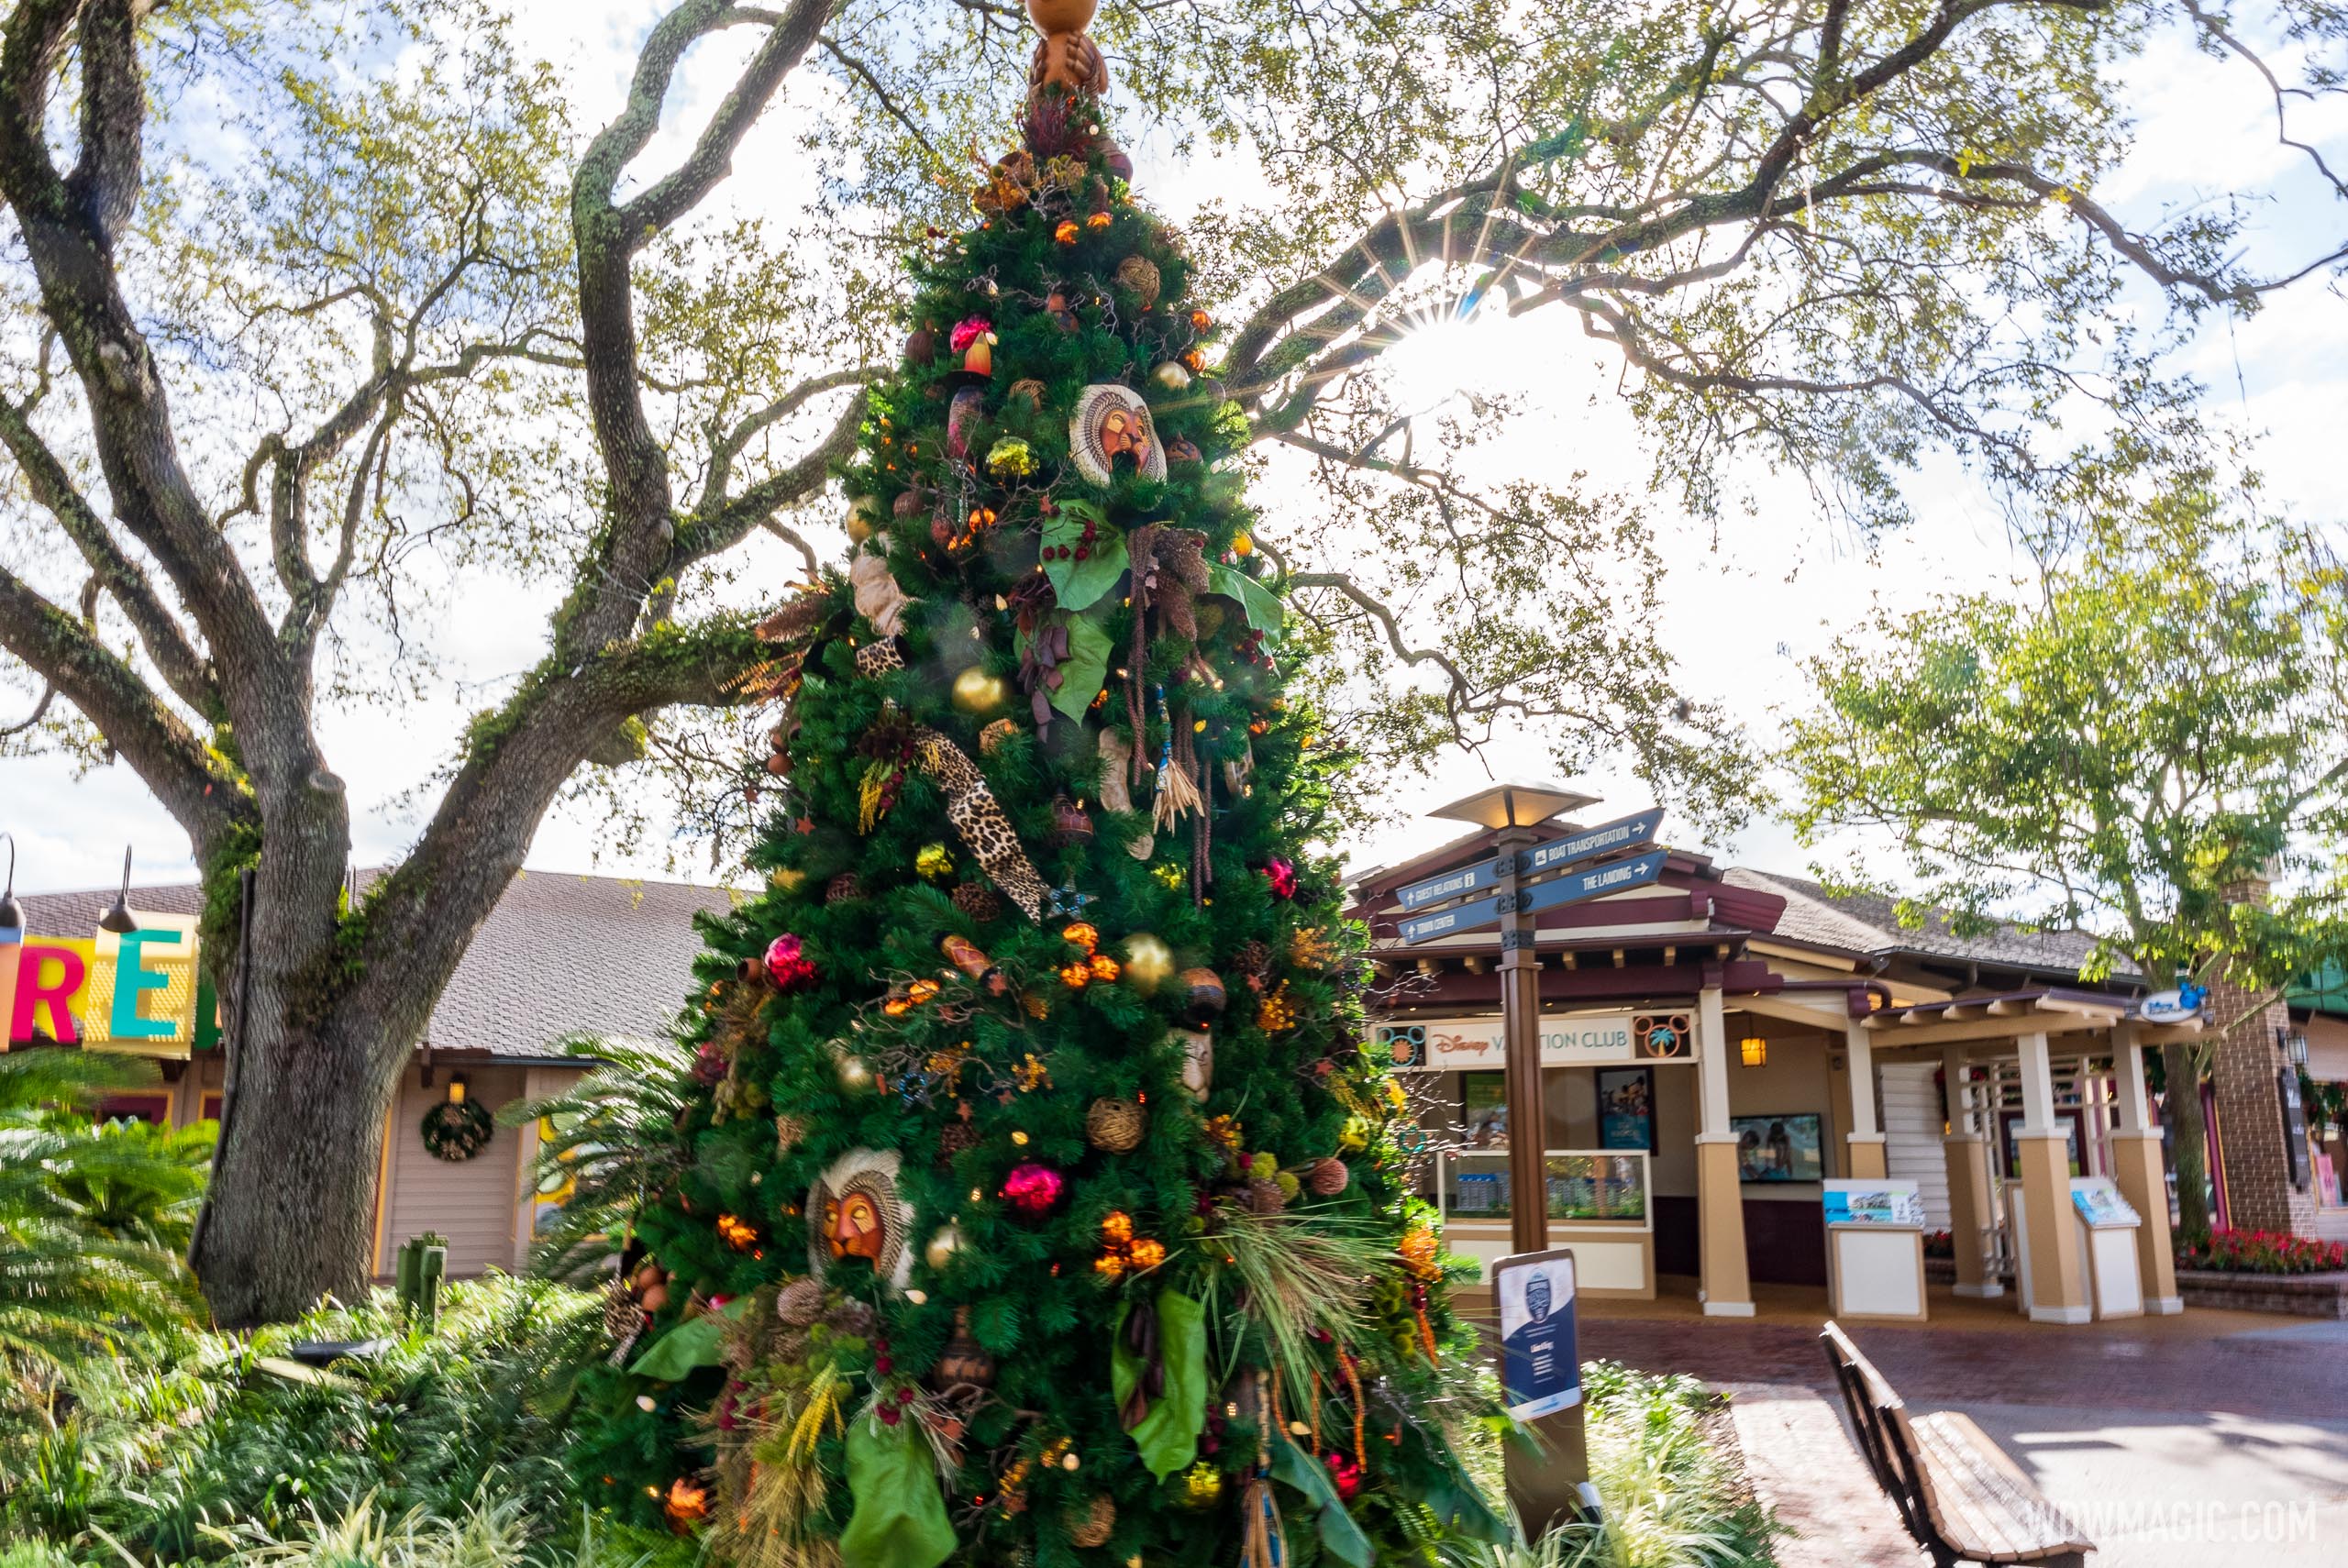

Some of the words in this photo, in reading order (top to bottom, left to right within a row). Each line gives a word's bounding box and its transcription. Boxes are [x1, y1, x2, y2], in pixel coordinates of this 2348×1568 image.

[1548, 845, 1567, 861] BOAT
[1567, 825, 1630, 856] TRANSPORTATION
[1415, 887, 1433, 901] GUEST
[1433, 877, 1464, 897] RELATIONS
[1582, 875, 1598, 890] THE
[1599, 866, 1632, 888] LANDING
[1432, 1033, 1489, 1056] Disney
[1491, 1032, 1577, 1051] VTION
[1581, 1031, 1627, 1048] CLUB
